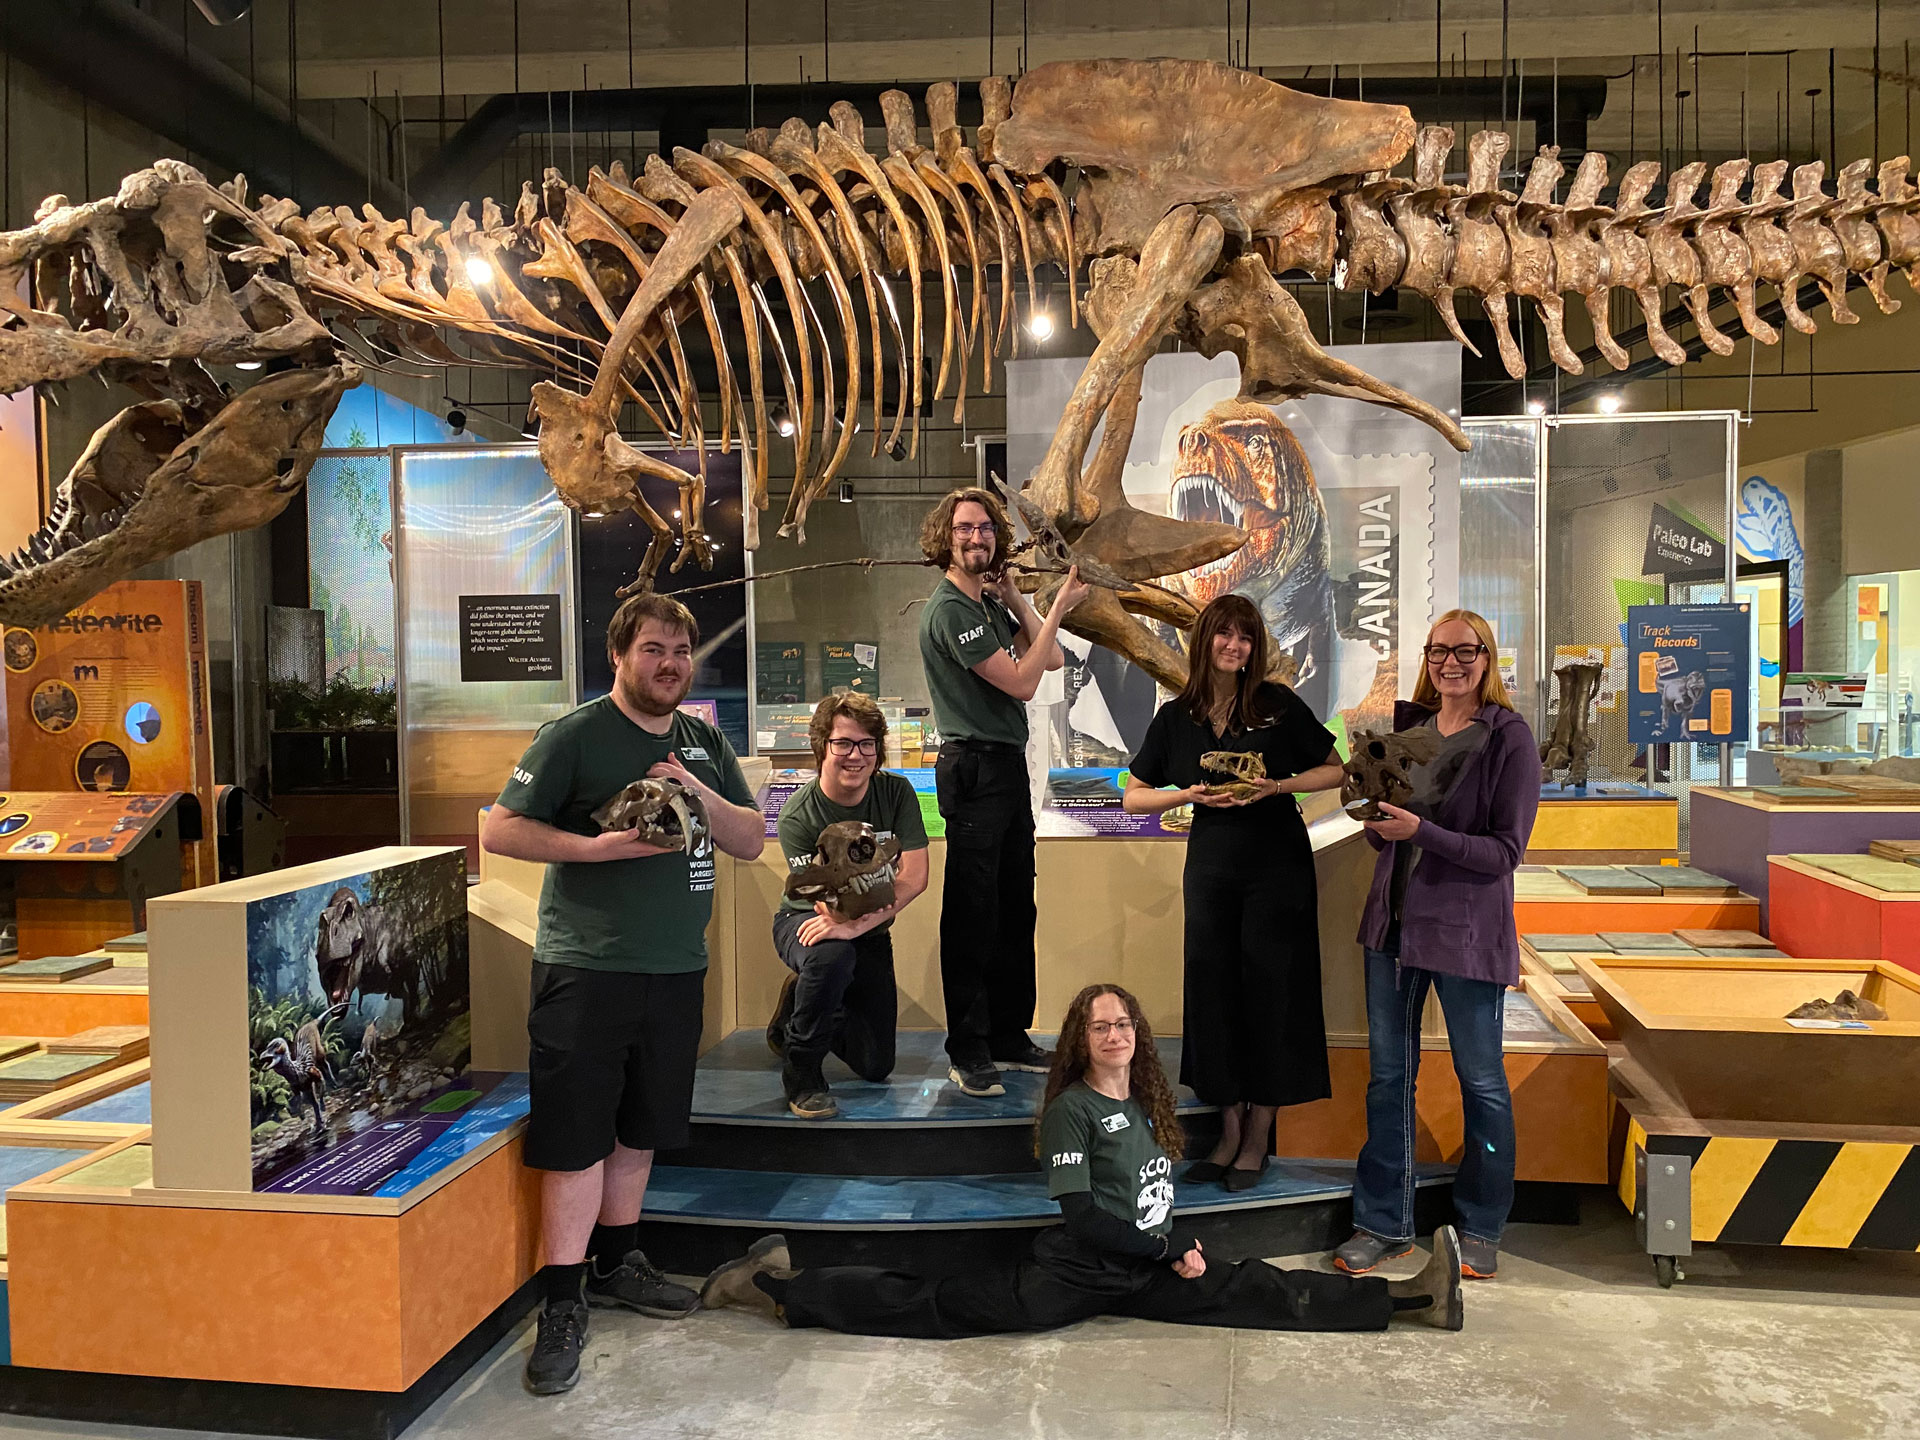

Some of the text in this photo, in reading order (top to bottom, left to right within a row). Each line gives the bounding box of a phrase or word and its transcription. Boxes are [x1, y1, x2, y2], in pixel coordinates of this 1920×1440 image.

[1653, 524, 1712, 557] Paleo Lab
[1358, 494, 1391, 661] CANADA
[524, 603, 550, 611] extinction
[189, 584, 199, 645] museum
[478, 612, 495, 620] follow
[525, 611, 536, 619] and
[525, 620, 532, 628] of
[500, 628, 517, 636] global
[958, 625, 984, 645] STAFF
[1643, 625, 1671, 636] Track
[499, 636, 526, 644] secondary
[1654, 636, 1698, 648] Records
[470, 645, 477, 653] of
[527, 664, 552, 672] geologist
[1073, 667, 1083, 688] REX
[1052, 1152, 1084, 1167] STAFF
